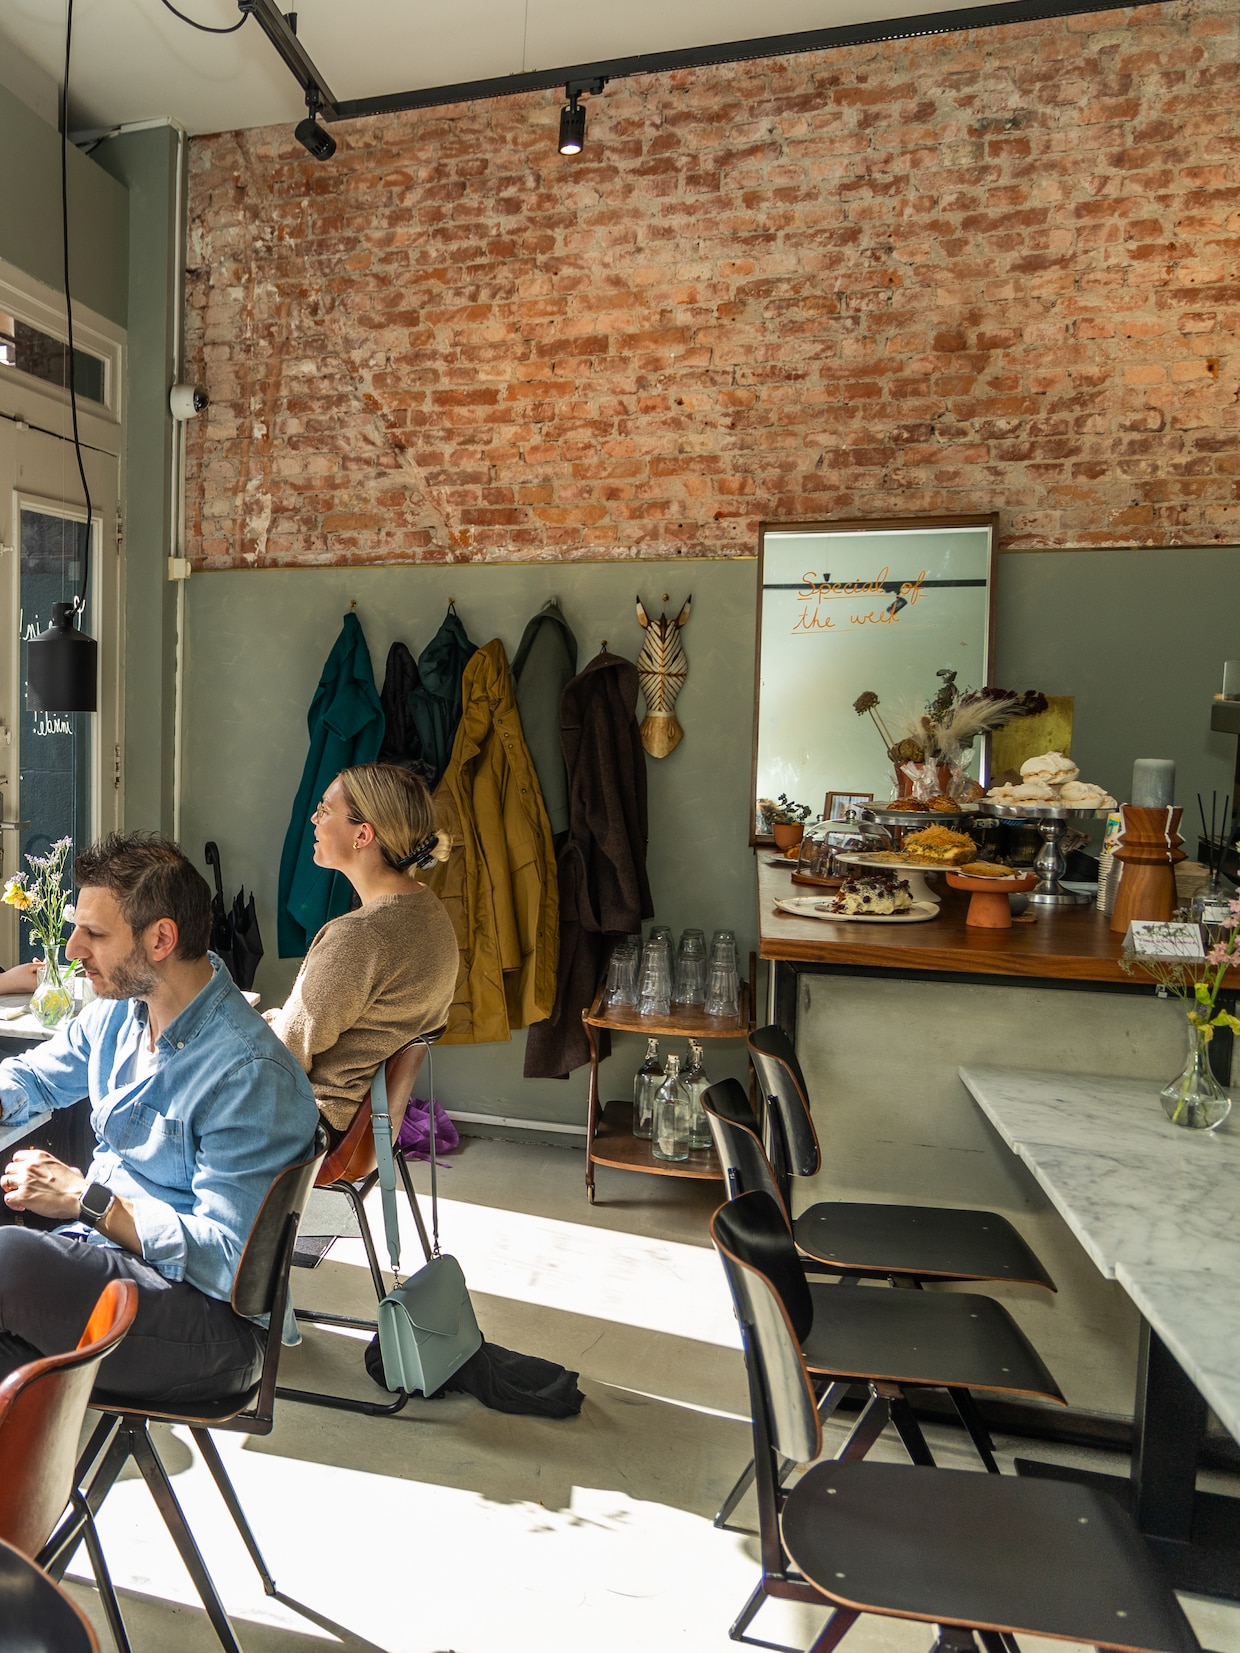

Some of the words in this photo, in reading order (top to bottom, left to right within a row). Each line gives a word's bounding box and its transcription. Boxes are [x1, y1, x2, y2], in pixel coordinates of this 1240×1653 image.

[798, 566, 889, 604] Special
[899, 569, 926, 605] of
[792, 605, 836, 630] the
[850, 602, 901, 625] week
